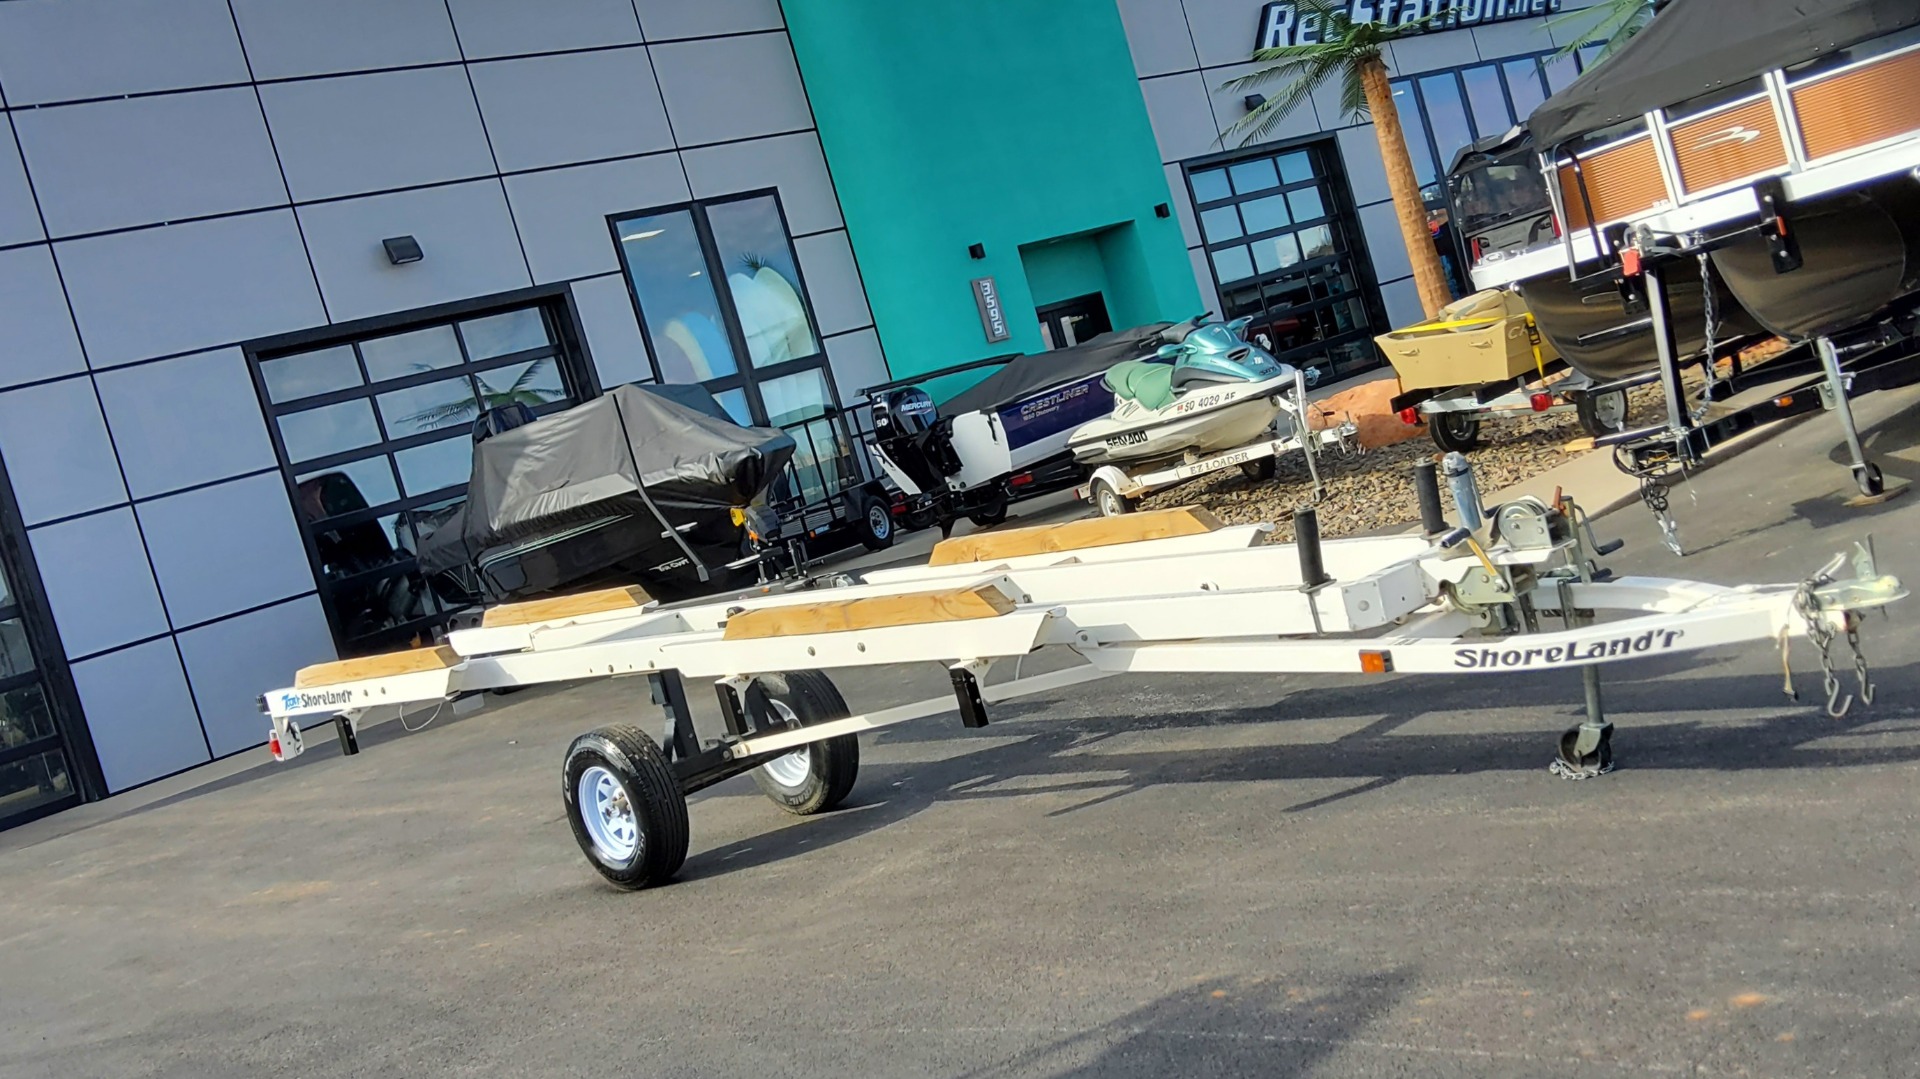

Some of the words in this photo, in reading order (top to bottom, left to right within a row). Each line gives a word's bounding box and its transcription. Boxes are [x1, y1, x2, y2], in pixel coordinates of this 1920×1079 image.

[982, 282, 1003, 334] 3595
[901, 401, 932, 412] MERCURY
[1020, 384, 1089, 415] CRESTLINER
[1198, 395, 1220, 407] 4029
[1190, 465, 1203, 475] EZ
[1205, 452, 1249, 470] LOADER
